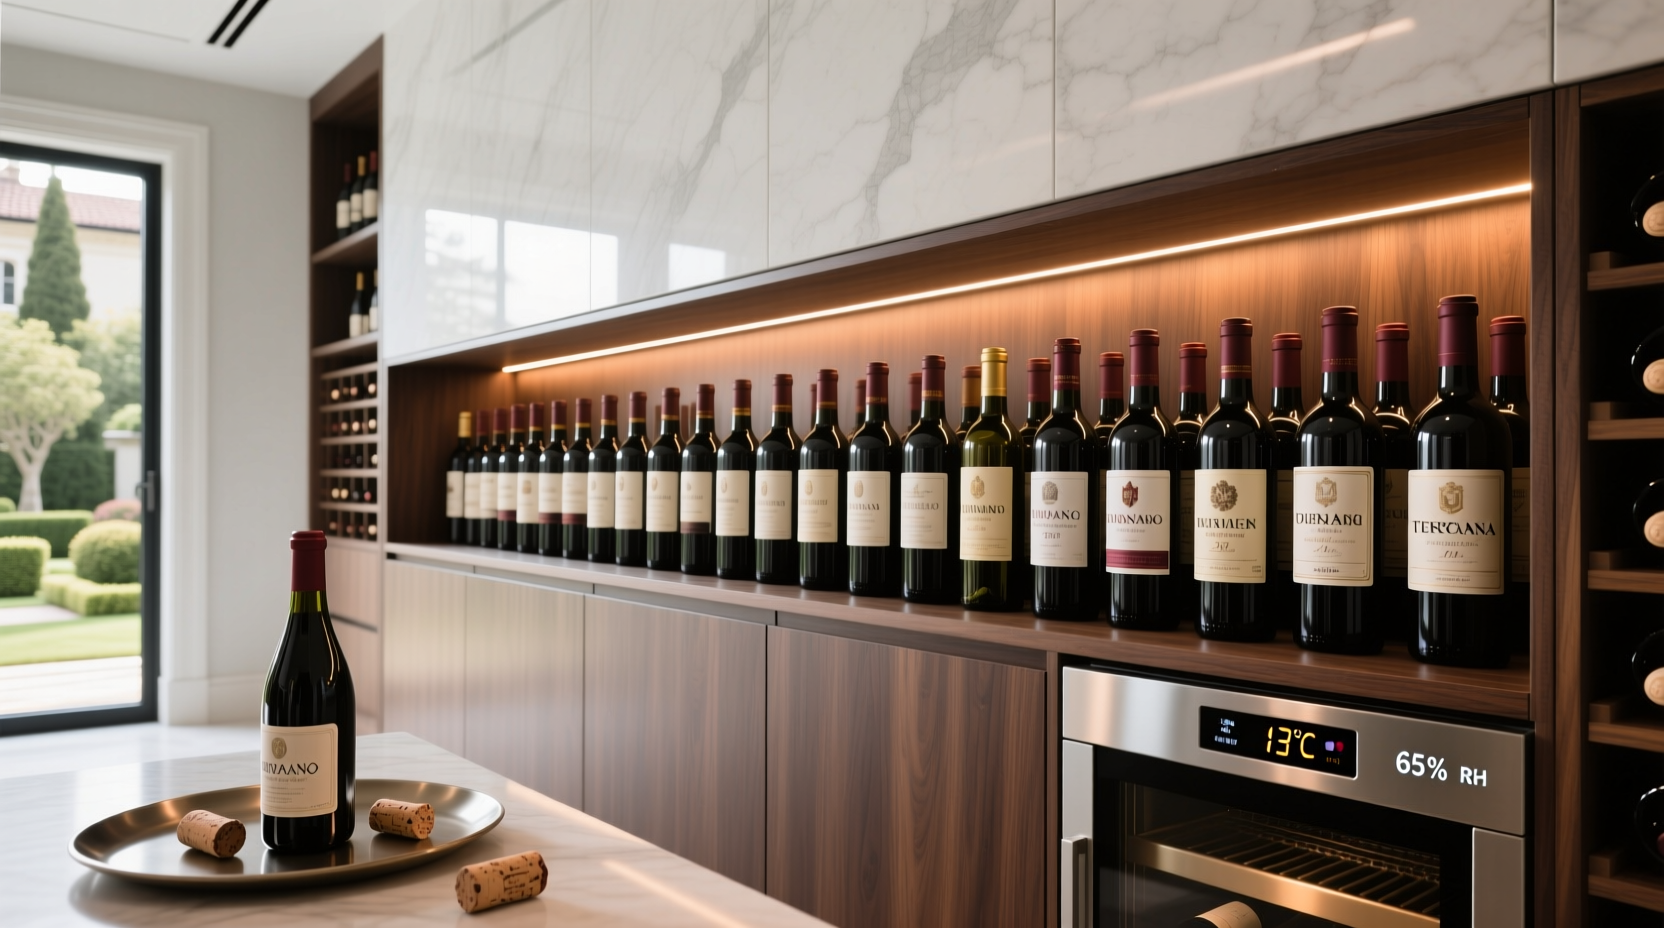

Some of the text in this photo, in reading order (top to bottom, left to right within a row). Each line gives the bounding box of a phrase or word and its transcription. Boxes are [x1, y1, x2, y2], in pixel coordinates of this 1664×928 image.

[1266, 726, 1316, 759] 13°C
[1396, 751, 1487, 787] 65% RH
